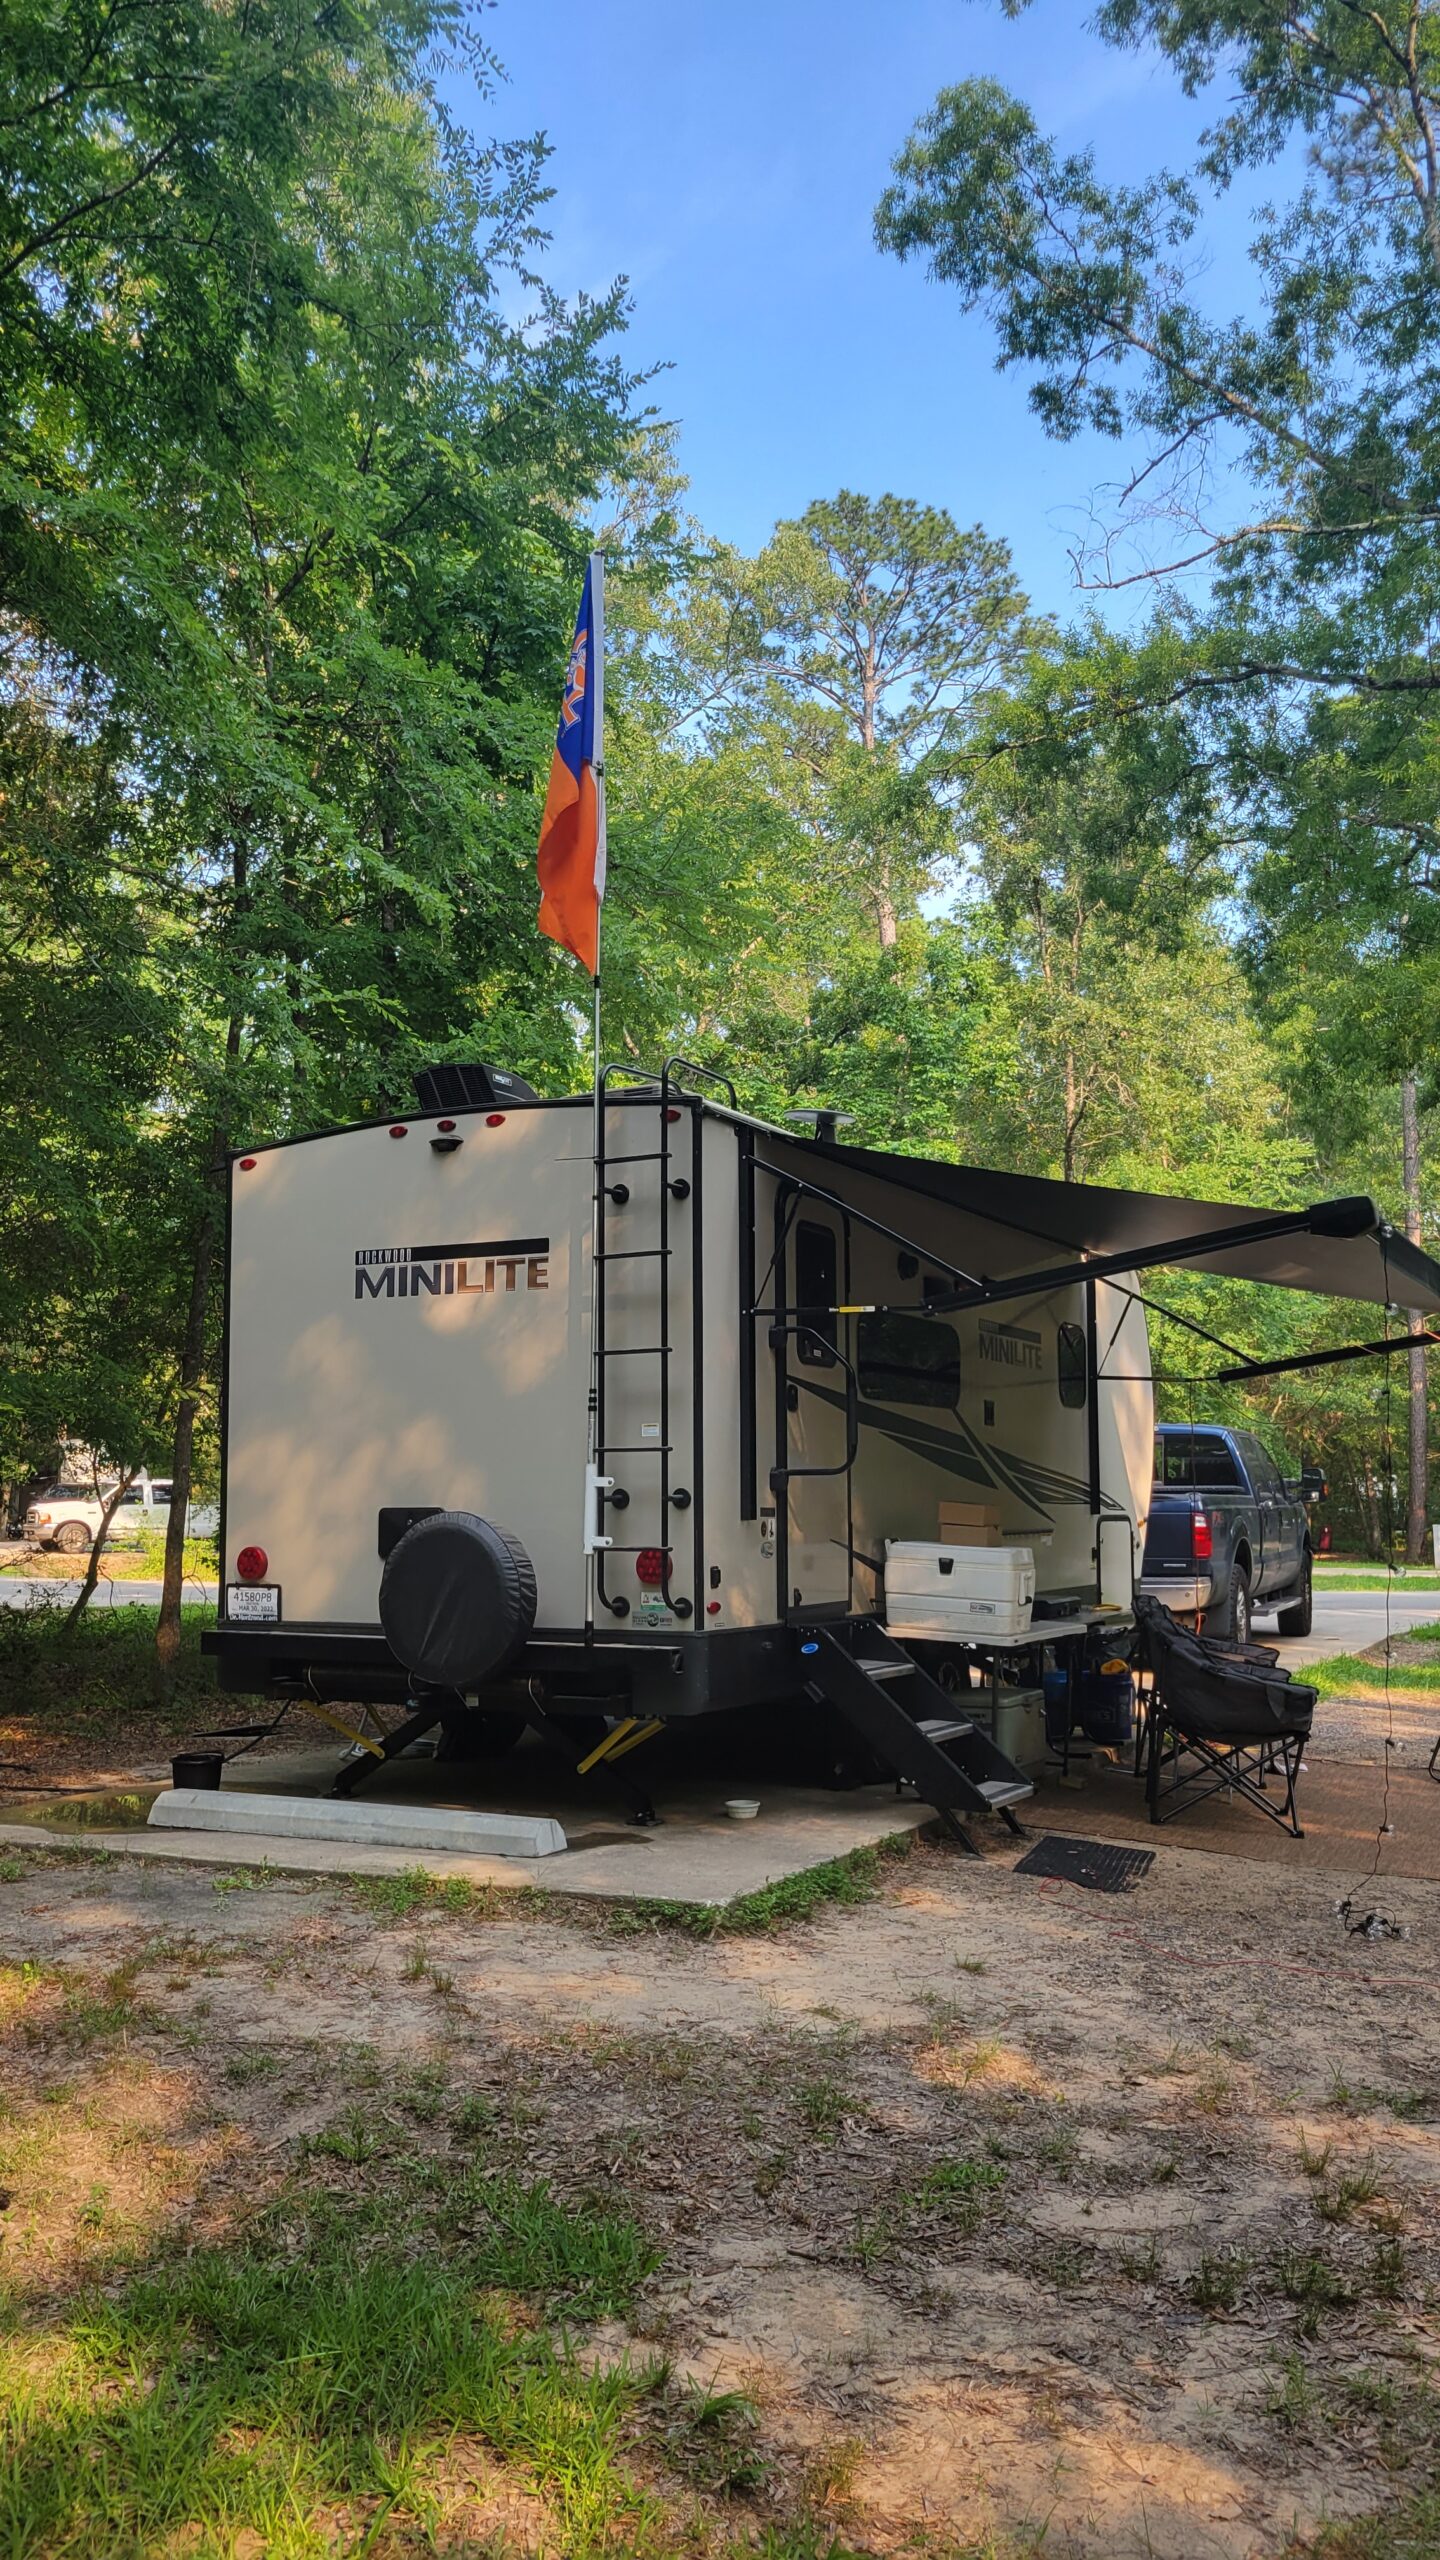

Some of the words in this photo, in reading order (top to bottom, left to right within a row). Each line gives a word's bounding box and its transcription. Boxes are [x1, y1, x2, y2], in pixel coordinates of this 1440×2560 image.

[358, 1248, 412, 1265] ROCKWOOD
[355, 1256, 549, 1300] MINILITE
[979, 1332, 1042, 1369] MINILITE
